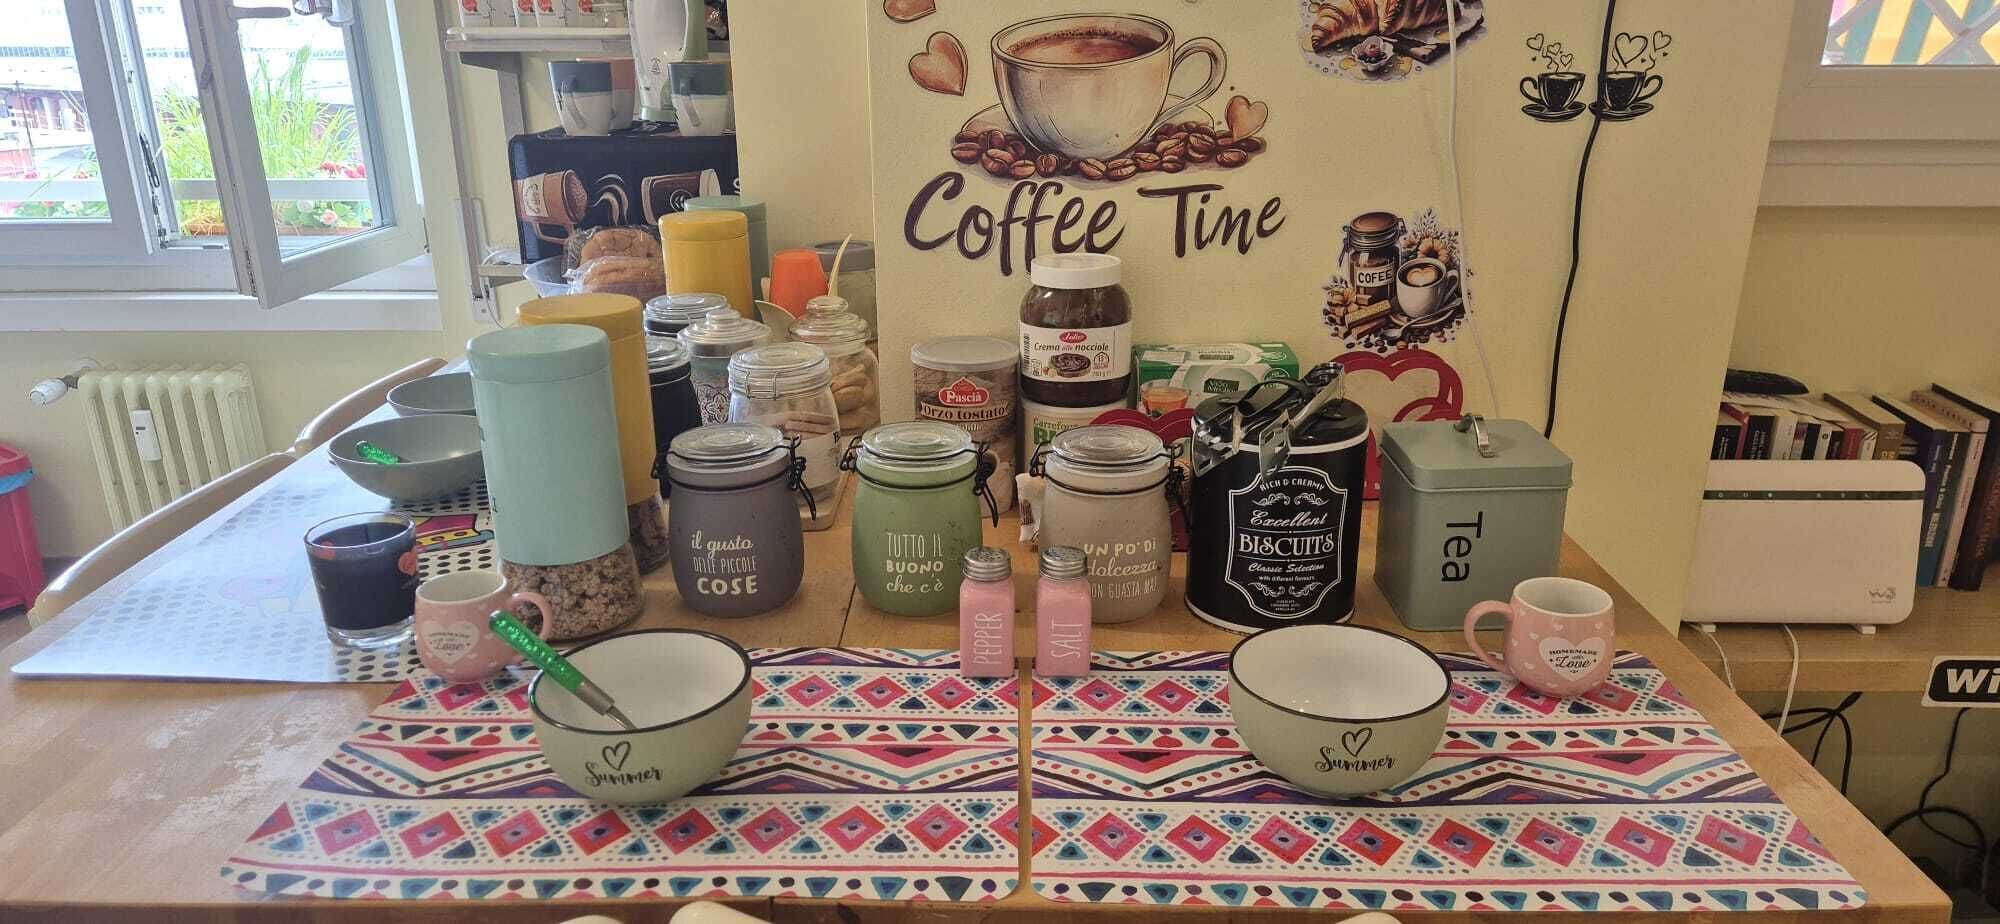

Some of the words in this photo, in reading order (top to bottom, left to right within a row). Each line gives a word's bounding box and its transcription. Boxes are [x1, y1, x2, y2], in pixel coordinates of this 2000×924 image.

[903, 171, 1125, 276] Coffee
[1358, 269, 1393, 284] COFEE
[1034, 342, 1060, 352] Crema
[1075, 343, 1109, 352] nocciole
[957, 406, 1006, 420] tostato
[1259, 478, 1281, 492] RICH
[1291, 478, 1325, 491] CREAMY
[1250, 509, 1328, 527] Excellent
[691, 530, 703, 550] il
[706, 534, 754, 559] gusto
[886, 532, 926, 558] TUTTO
[933, 533, 944, 557] IL
[1084, 543, 1109, 556] UN
[1239, 533, 1335, 557] BISCUITS
[1441, 511, 1484, 582] Tea
[693, 557, 717, 575] DELLE
[721, 555, 757, 574] PICCOLE
[886, 560, 944, 574] BUONO
[1248, 562, 1283, 573] Classic
[1285, 562, 1325, 573] Selection
[697, 575, 759, 595] COSE
[886, 574, 915, 594] che
[1091, 583, 1104, 598] ON
[1109, 580, 1140, 599] GUASTA
[972, 612, 1003, 665] PEPPER
[1050, 615, 1083, 658] SALT
[1555, 655, 1591, 668] Love
[1314, 745, 1395, 772] Summer
[585, 761, 662, 787] Summer
